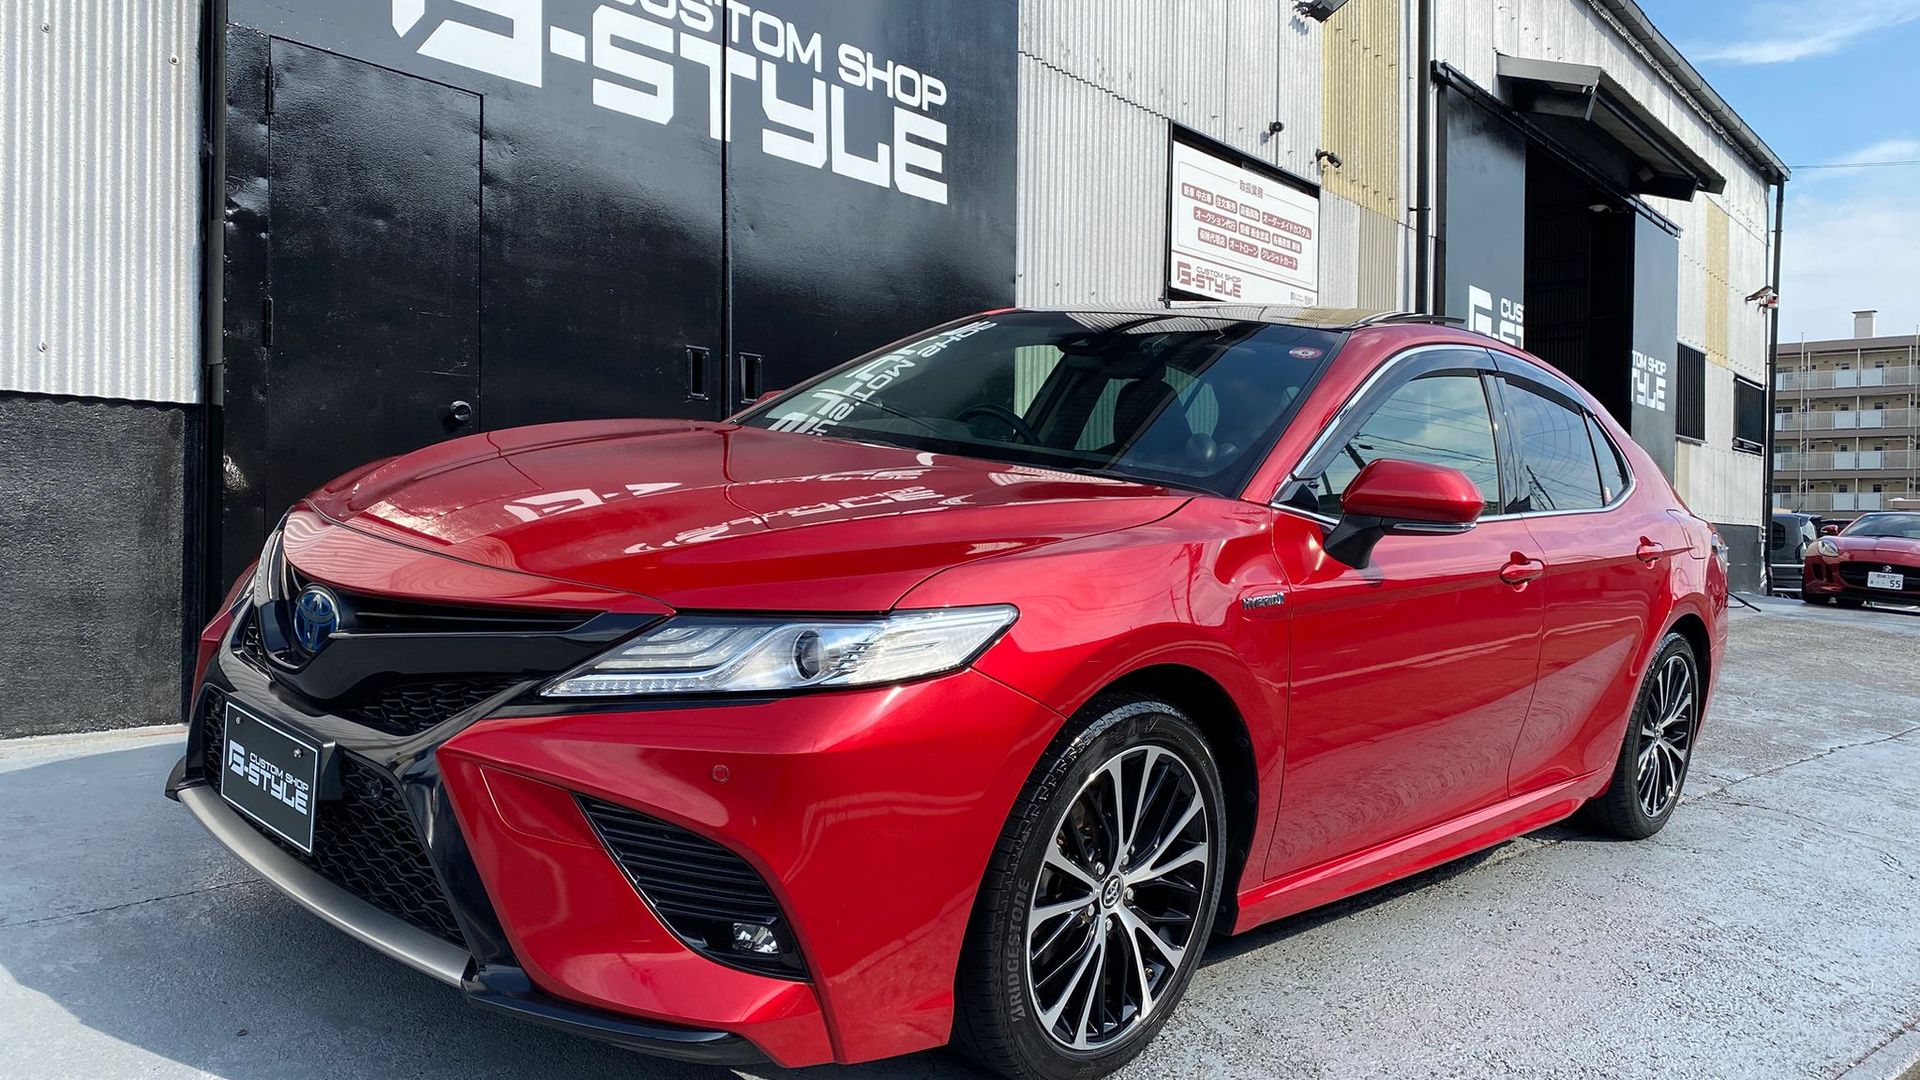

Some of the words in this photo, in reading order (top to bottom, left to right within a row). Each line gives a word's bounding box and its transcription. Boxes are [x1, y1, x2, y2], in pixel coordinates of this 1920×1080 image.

[837, 43, 947, 111] SHOP
[1195, 207, 1235, 231] オークション代行
[1263, 213, 1310, 238] オーダーメイドカスタム
[1229, 238, 1257, 257] オートローン
[1261, 248, 1296, 269] クレジットカード
[1177, 261, 1241, 298] G-STYLE
[1196, 266, 1223, 279] CUSTOM
[1224, 273, 1241, 283] SHOP
[1648, 356, 1666, 376] SHOP
[228, 739, 309, 816] G-STYLE
[249, 752, 284, 779] CUSTOM
[285, 772, 309, 791] SHOP
[1007, 878, 1030, 1023] BRIDGESTONE
